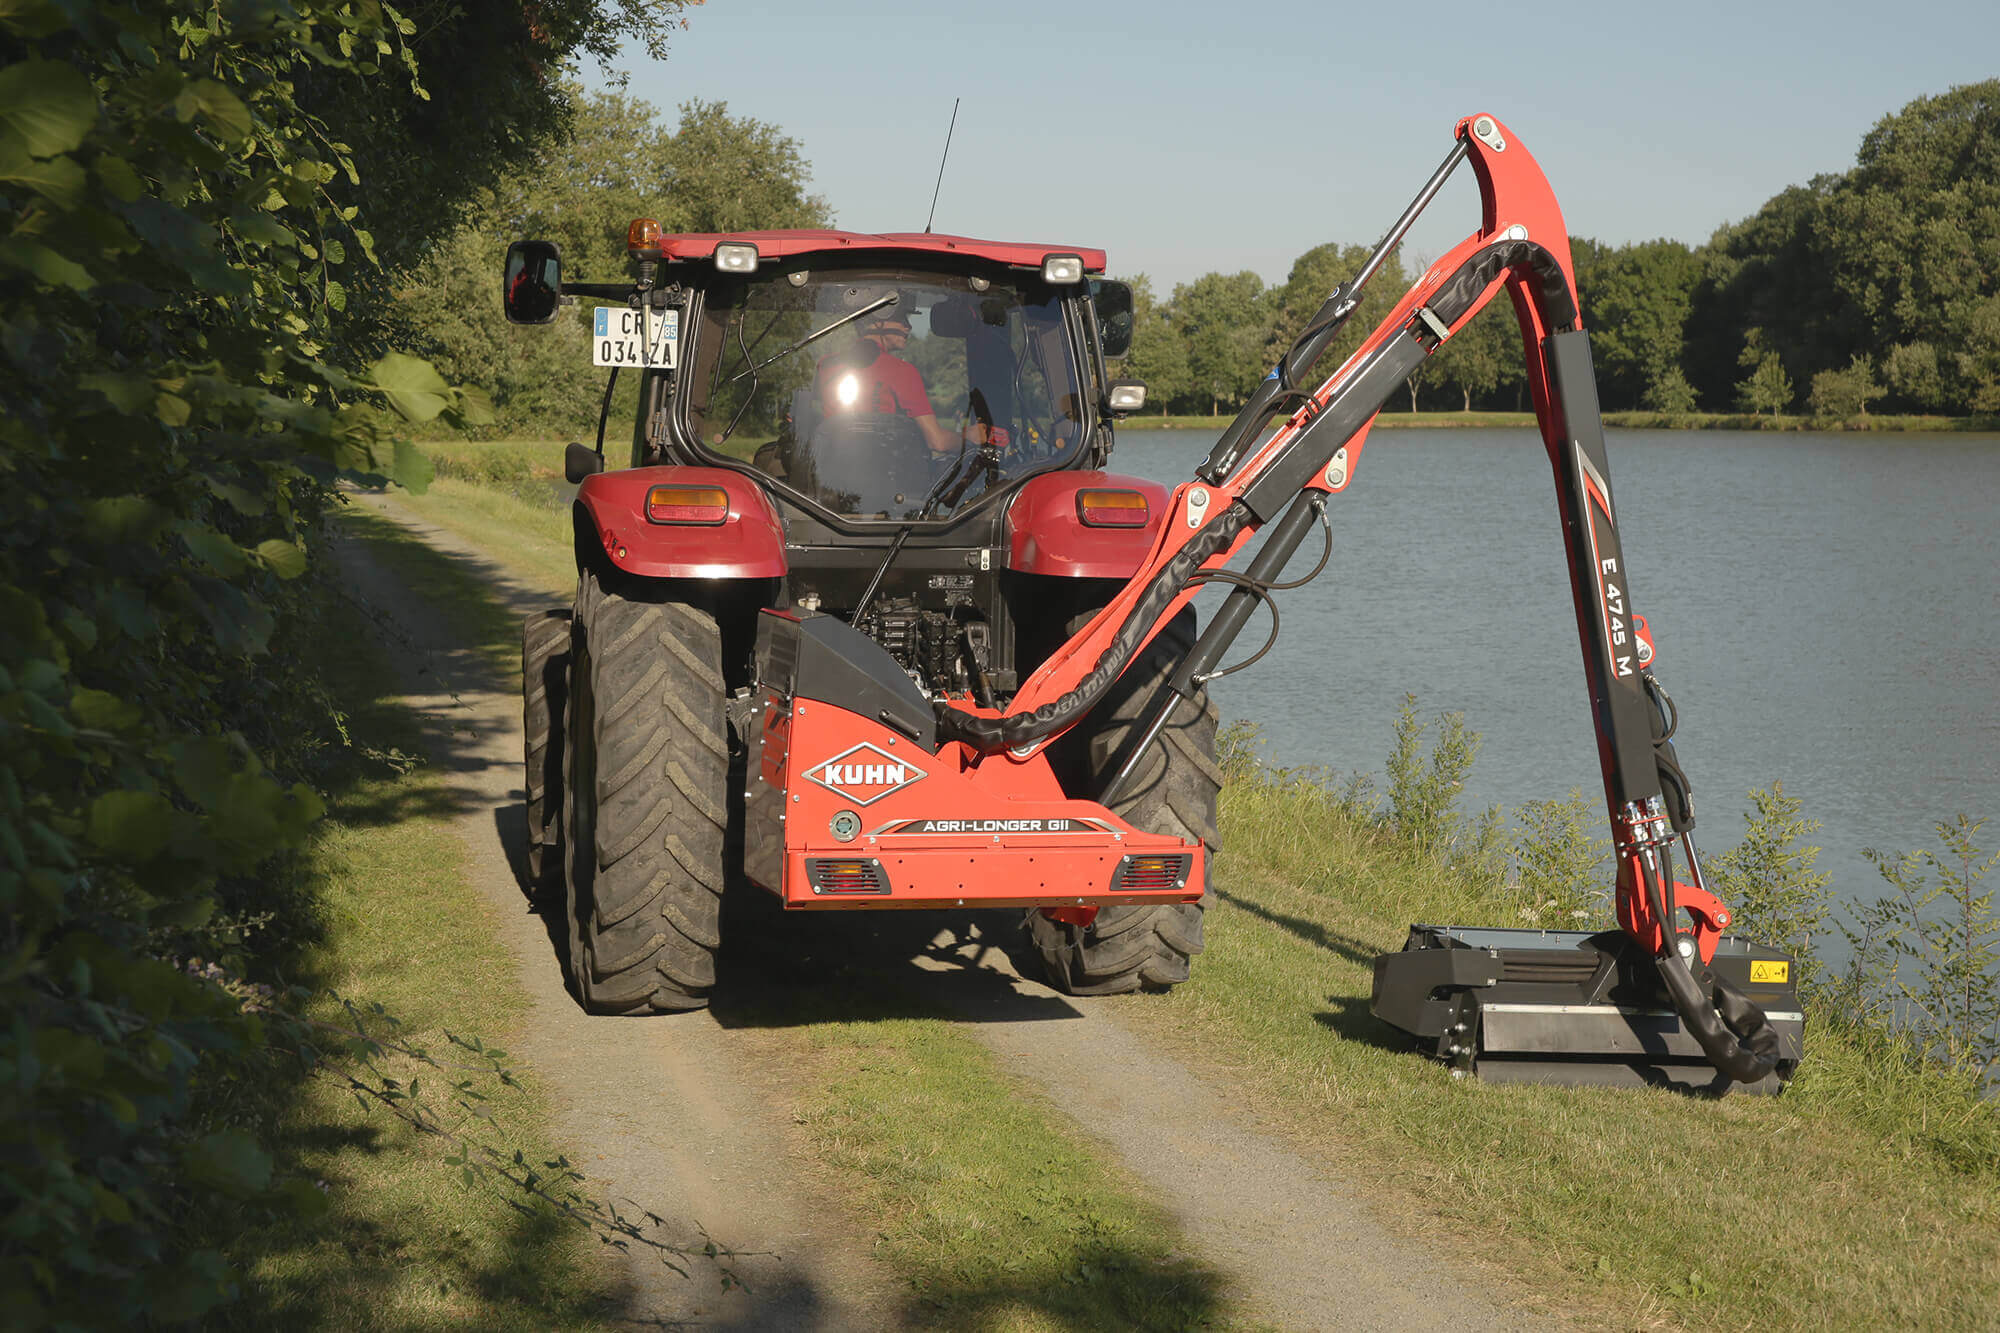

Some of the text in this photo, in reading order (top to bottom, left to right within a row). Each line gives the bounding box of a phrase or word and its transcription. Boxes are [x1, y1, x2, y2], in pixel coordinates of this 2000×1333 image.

[664, 326, 677, 337] 85
[1601, 558, 1633, 677] E 4745 M
[824, 764, 905, 785] KUHN
[923, 819, 1070, 832] AGRI-LONGER GII
